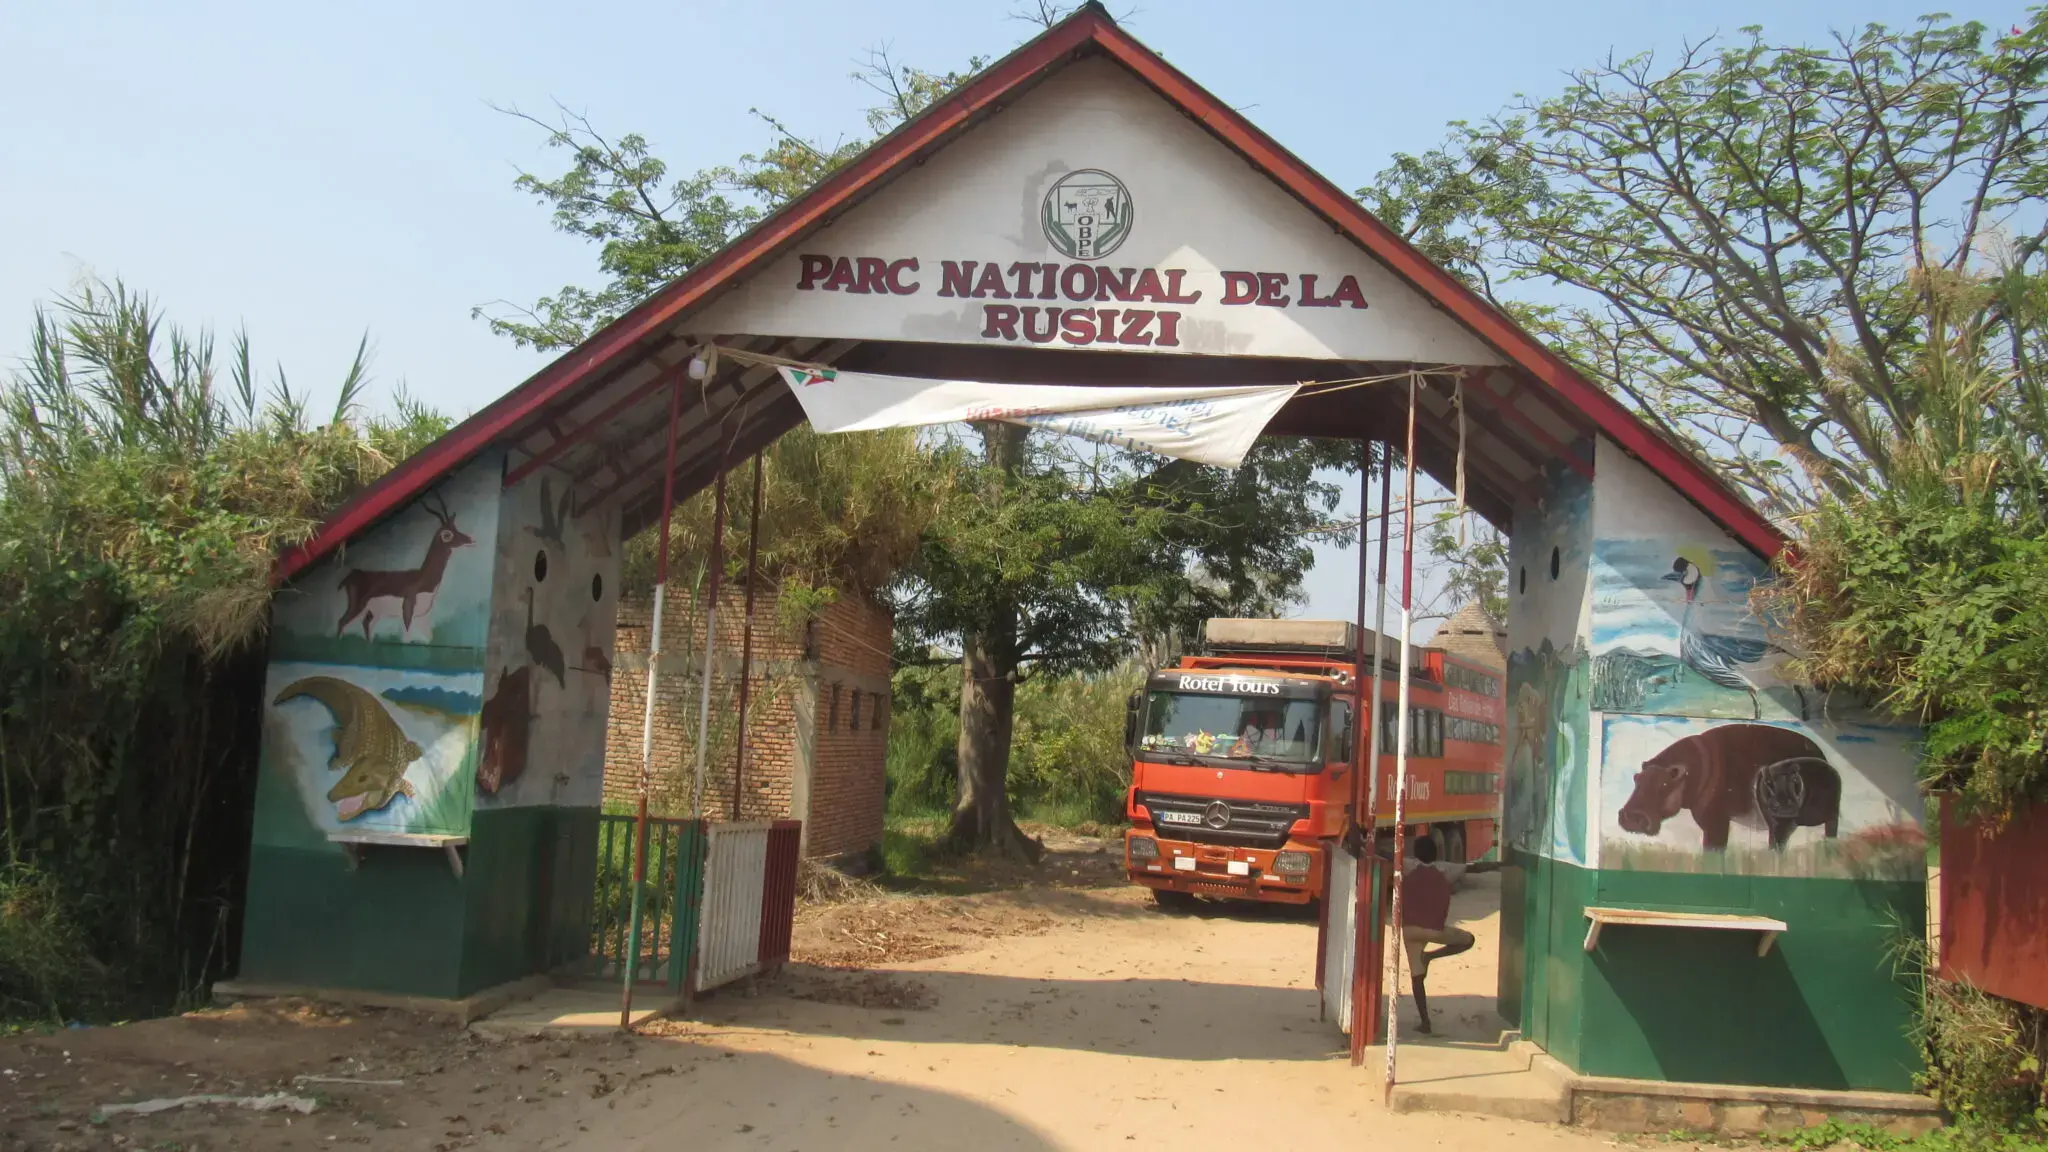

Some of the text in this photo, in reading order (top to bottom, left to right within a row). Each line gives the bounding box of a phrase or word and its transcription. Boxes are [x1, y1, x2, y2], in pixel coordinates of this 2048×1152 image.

[1076, 215, 1094, 257] OBPE
[796, 254, 1368, 309] PARC NATIONAL DE LA
[981, 303, 1181, 346] RUSIZI
[1178, 674, 1281, 695] Rotel Tours
[1410, 773, 1430, 800] Tours
[1164, 813, 1175, 822] PA
